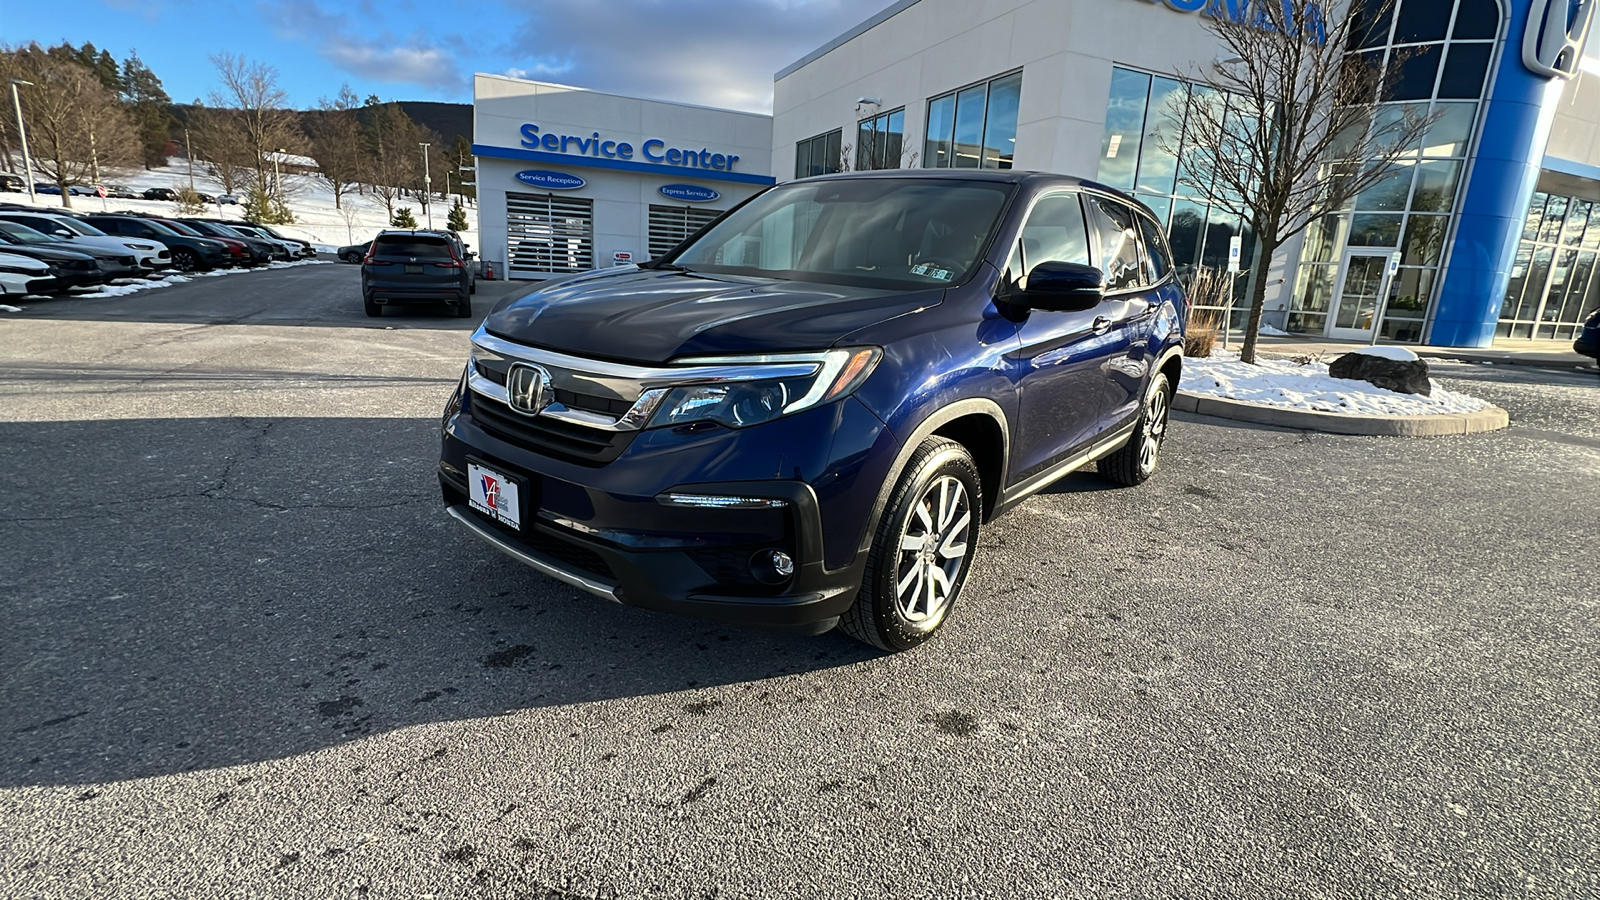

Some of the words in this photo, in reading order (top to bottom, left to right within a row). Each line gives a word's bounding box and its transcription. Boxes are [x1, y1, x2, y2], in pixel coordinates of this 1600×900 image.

[520, 123, 634, 160] Service
[642, 138, 740, 171] Center
[519, 172, 546, 182] Service
[546, 175, 581, 185] Reception
[662, 187, 685, 195] Express
[686, 189, 708, 197] Service
